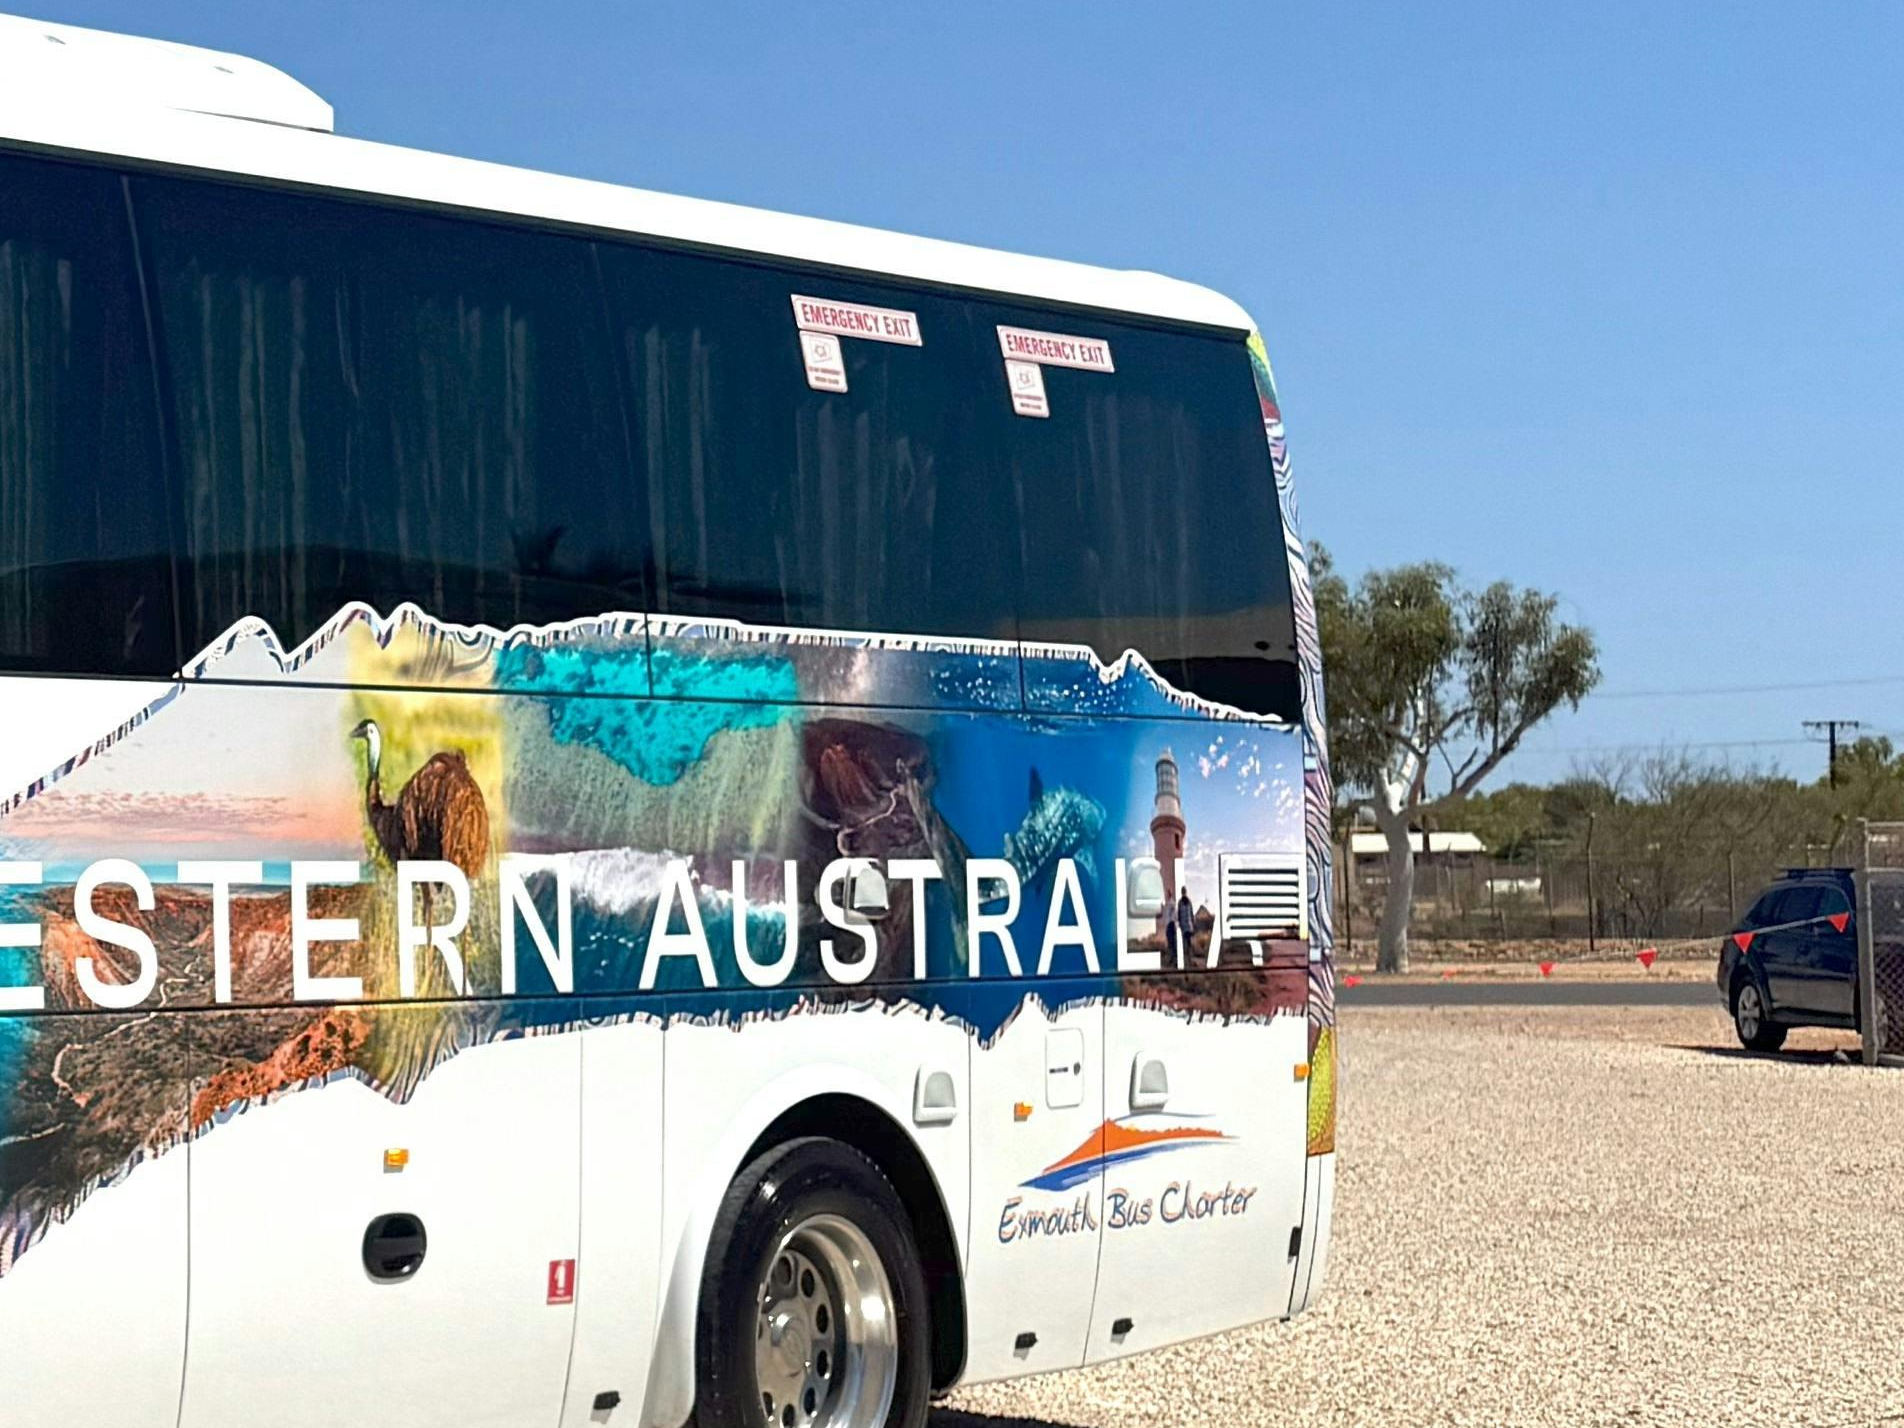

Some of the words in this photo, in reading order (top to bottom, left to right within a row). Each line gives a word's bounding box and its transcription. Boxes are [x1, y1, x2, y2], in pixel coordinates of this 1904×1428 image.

[801, 303, 880, 333] EMERGENCY
[882, 316, 912, 338] EXIT
[1005, 333, 1077, 360] EMERGENCY
[1079, 344, 1105, 365] EXIT
[998, 1191, 1098, 1244] Exmouth
[1106, 1187, 1153, 1230] Bus
[1160, 1180, 1258, 1224] Charter
